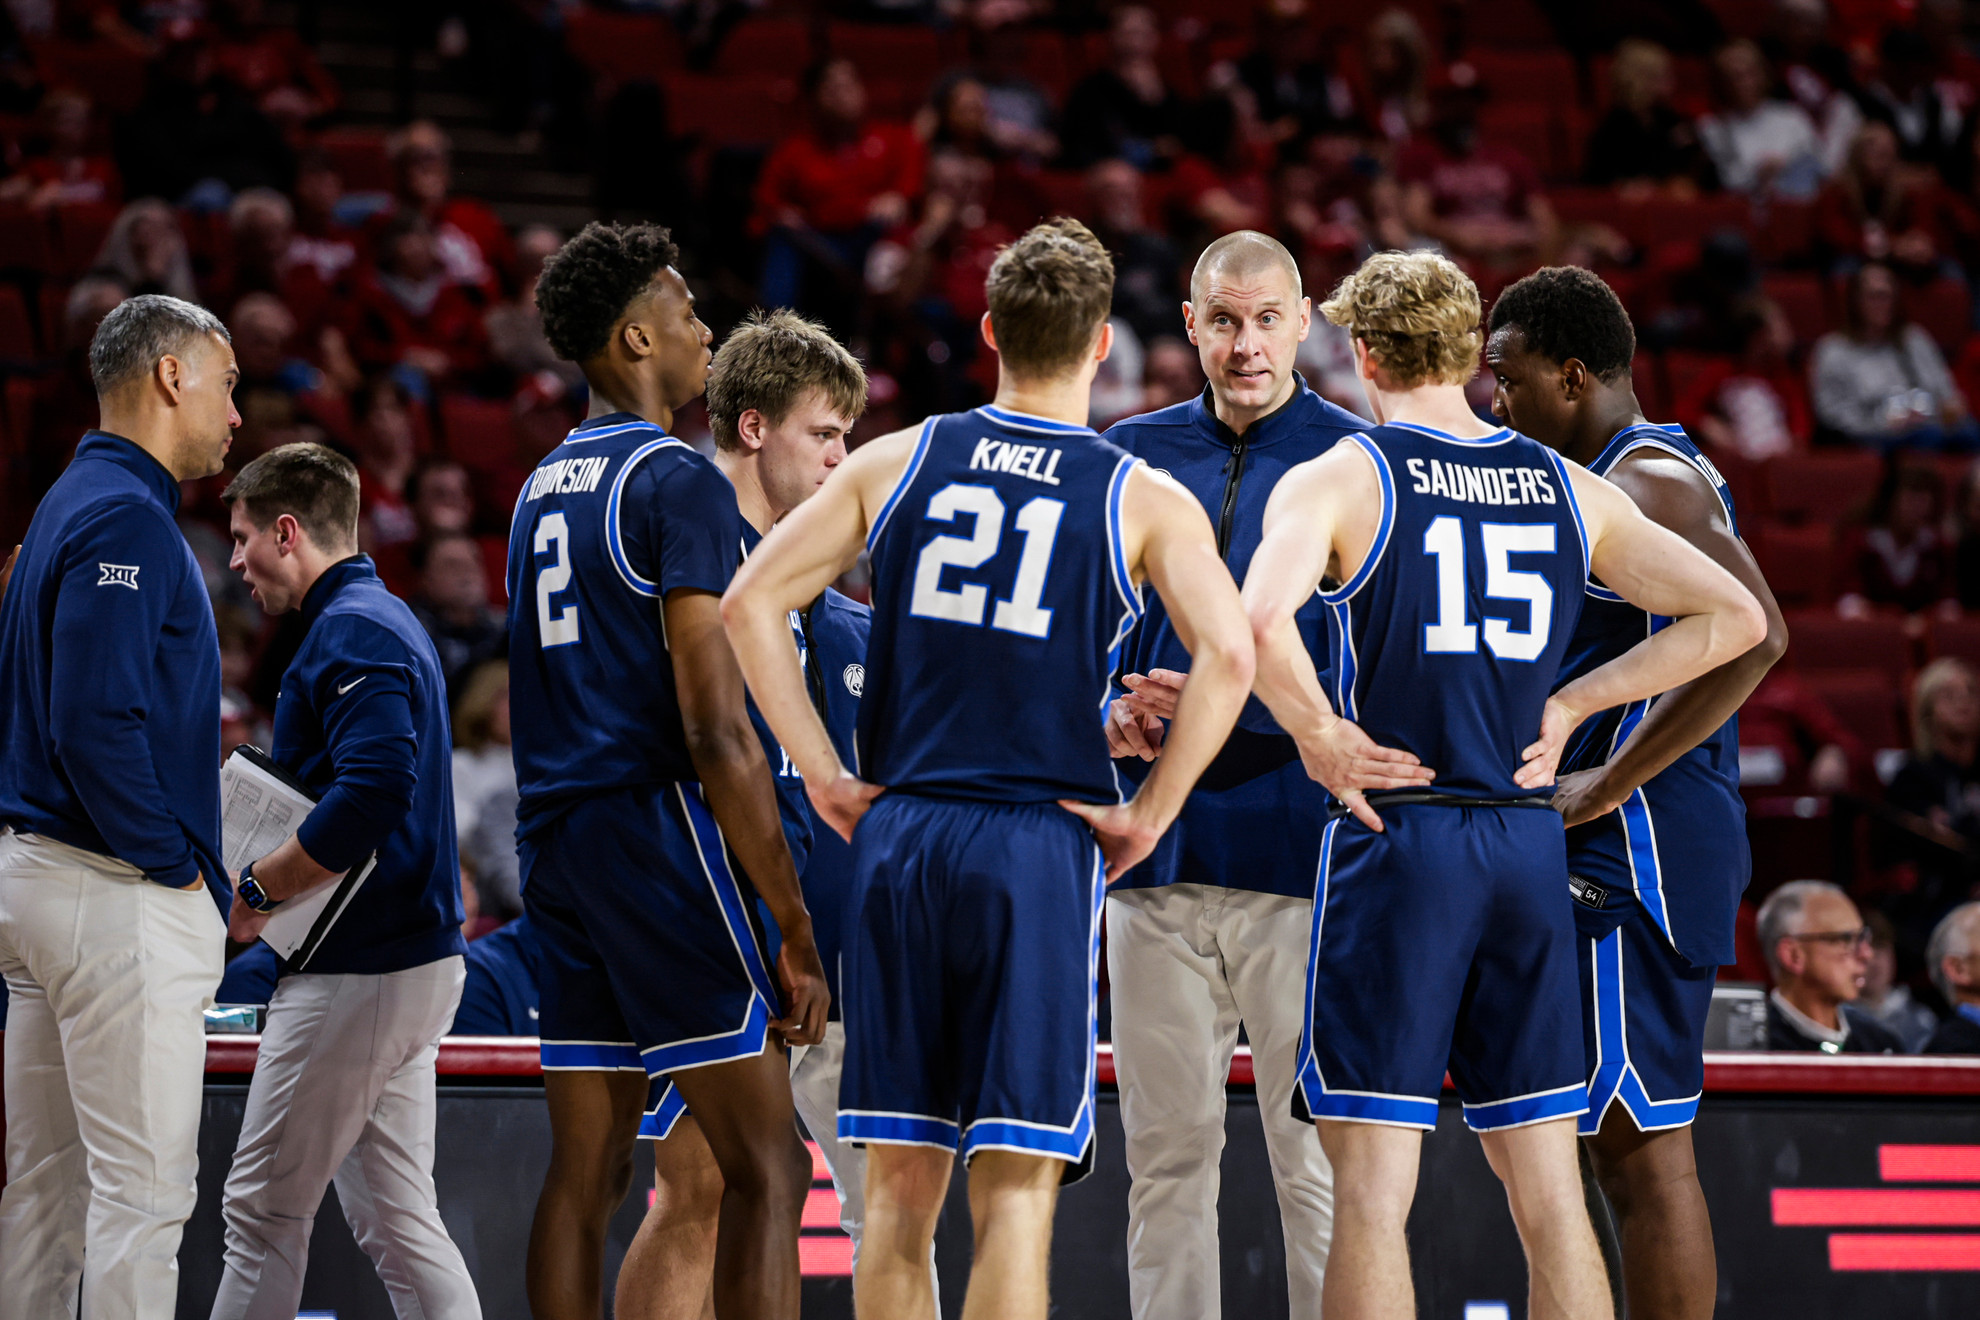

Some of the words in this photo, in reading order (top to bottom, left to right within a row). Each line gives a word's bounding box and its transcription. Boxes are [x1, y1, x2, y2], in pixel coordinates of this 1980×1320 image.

[525, 456, 610, 503] RONSON
[969, 437, 1063, 486] KNELL
[1406, 458, 1557, 506] SAUNDERS
[533, 509, 582, 650] 2
[909, 480, 1068, 640] 21
[1423, 514, 1558, 664] 15
[1585, 889, 1597, 901] 54
